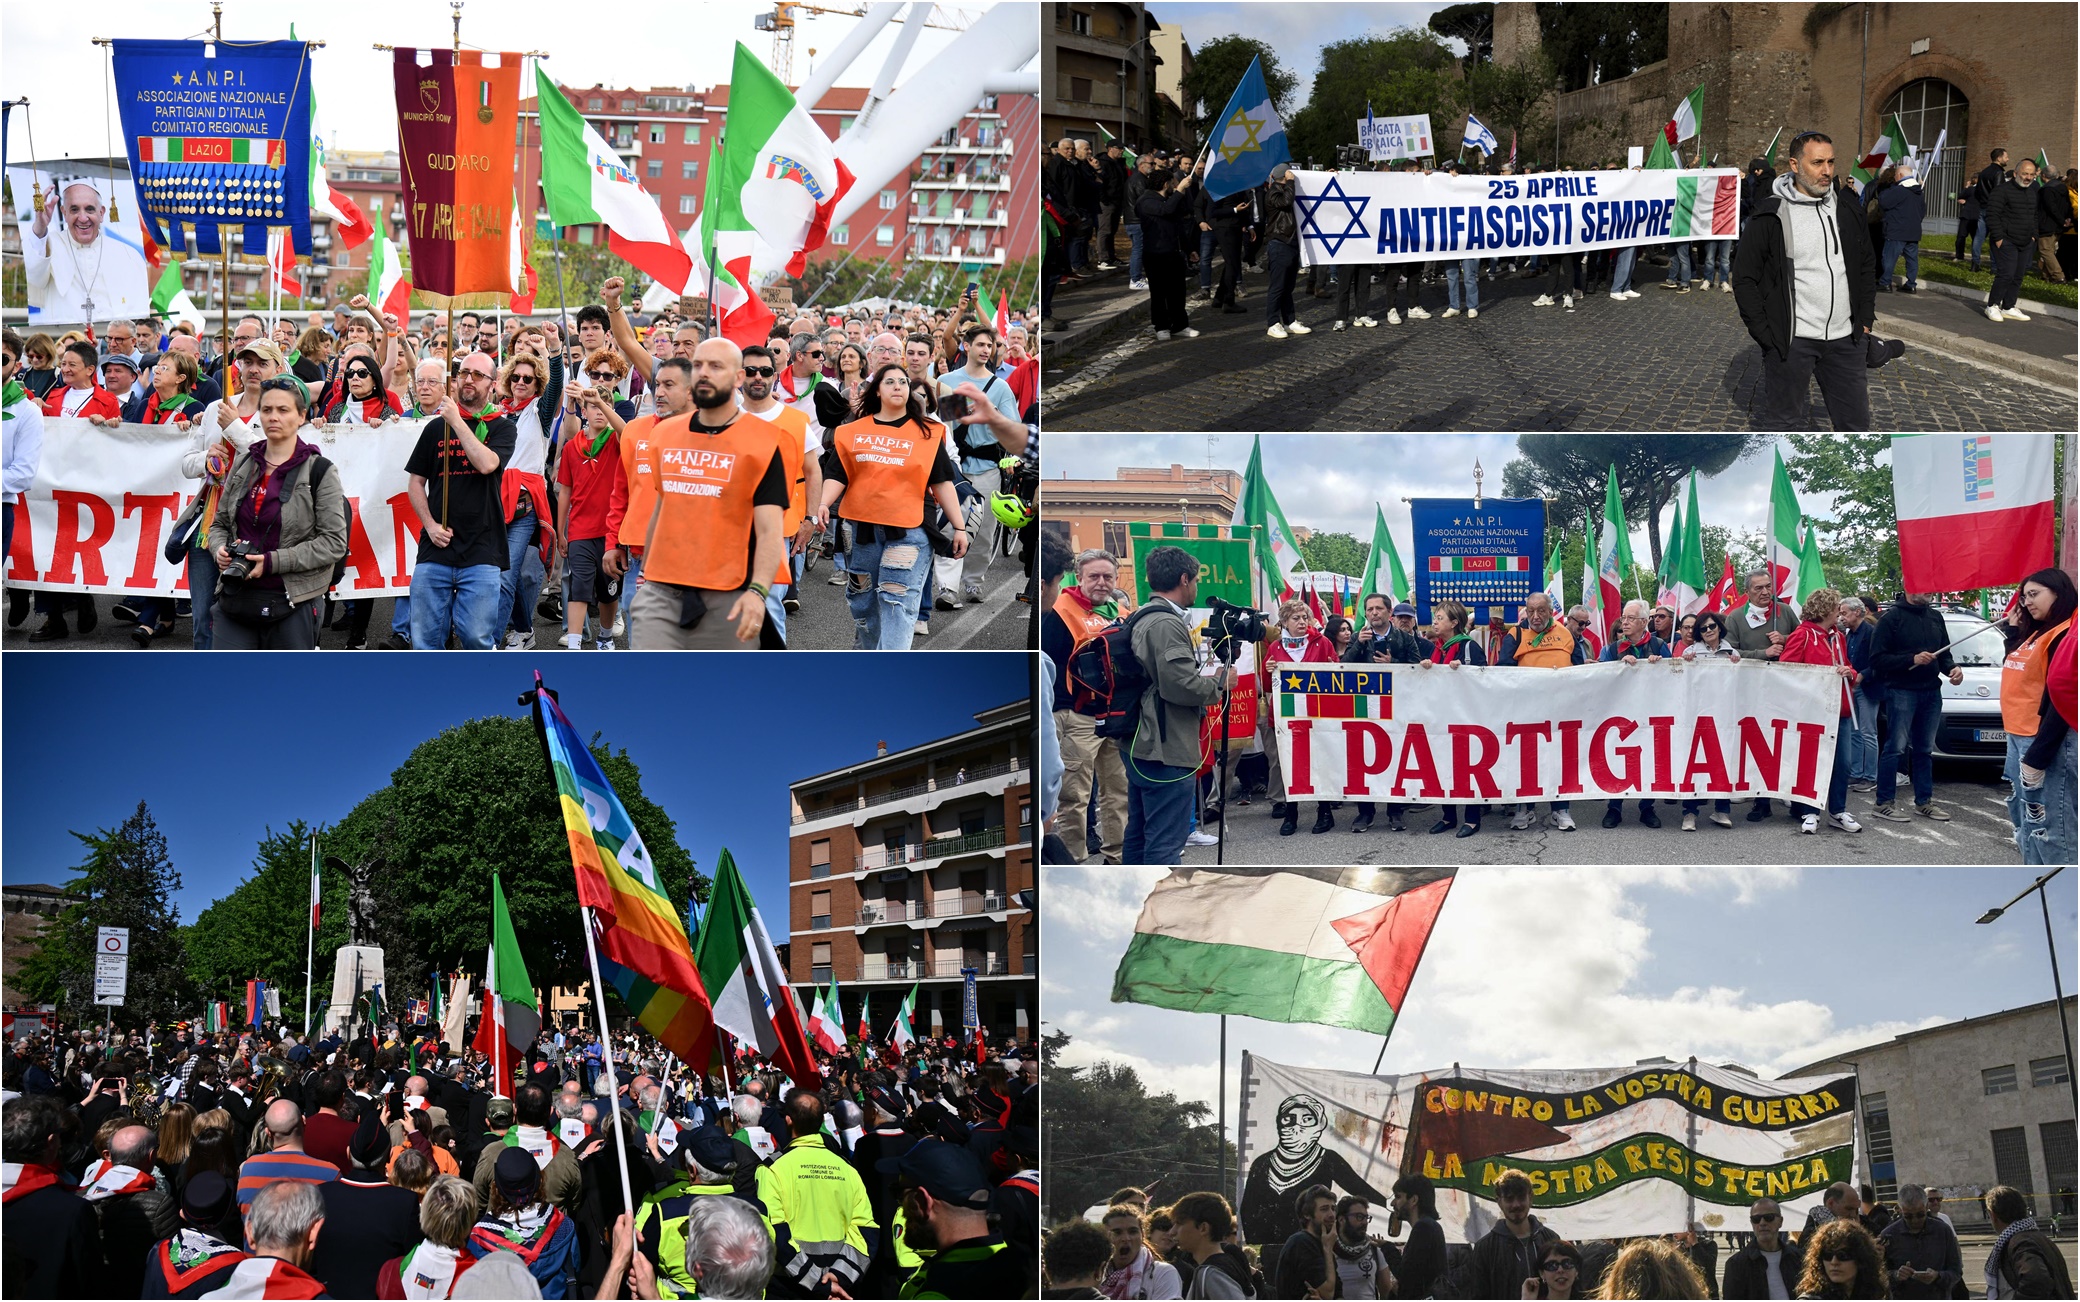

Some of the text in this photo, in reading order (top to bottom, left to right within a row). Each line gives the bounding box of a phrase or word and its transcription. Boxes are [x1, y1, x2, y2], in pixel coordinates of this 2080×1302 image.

[136, 90, 286, 104] ASSOCIAZIONE NAZIONALE
[155, 106, 266, 119] PARTIGIANI D'ITALIA
[403, 112, 435, 122] MUNICIPIO
[152, 121, 268, 135] COMITATO REGIONALE
[190, 144, 223, 156] LAZIO
[1488, 176, 1598, 200] 25 APRILE
[412, 202, 428, 238] 17
[469, 203, 503, 241] 1944
[1377, 198, 1676, 255] ANTIFASCISTI SEMPRE
[856, 454, 905, 466] ORGANIZZAZIONE
[680, 466, 704, 476] Roma
[1487, 528, 1529, 536] NAZIONALE
[1486, 537, 1516, 545] D'ITALIA
[1480, 546, 1518, 554] REGIONALE
[1467, 560, 1491, 568] LAZIO
[1287, 716, 1826, 801] I PARTIGIANI
[1425, 1073, 1840, 1125] CONTRO LA VOSTRA GUERRA
[1422, 1142, 1830, 1198] LA NSTRA RESISTENZA
